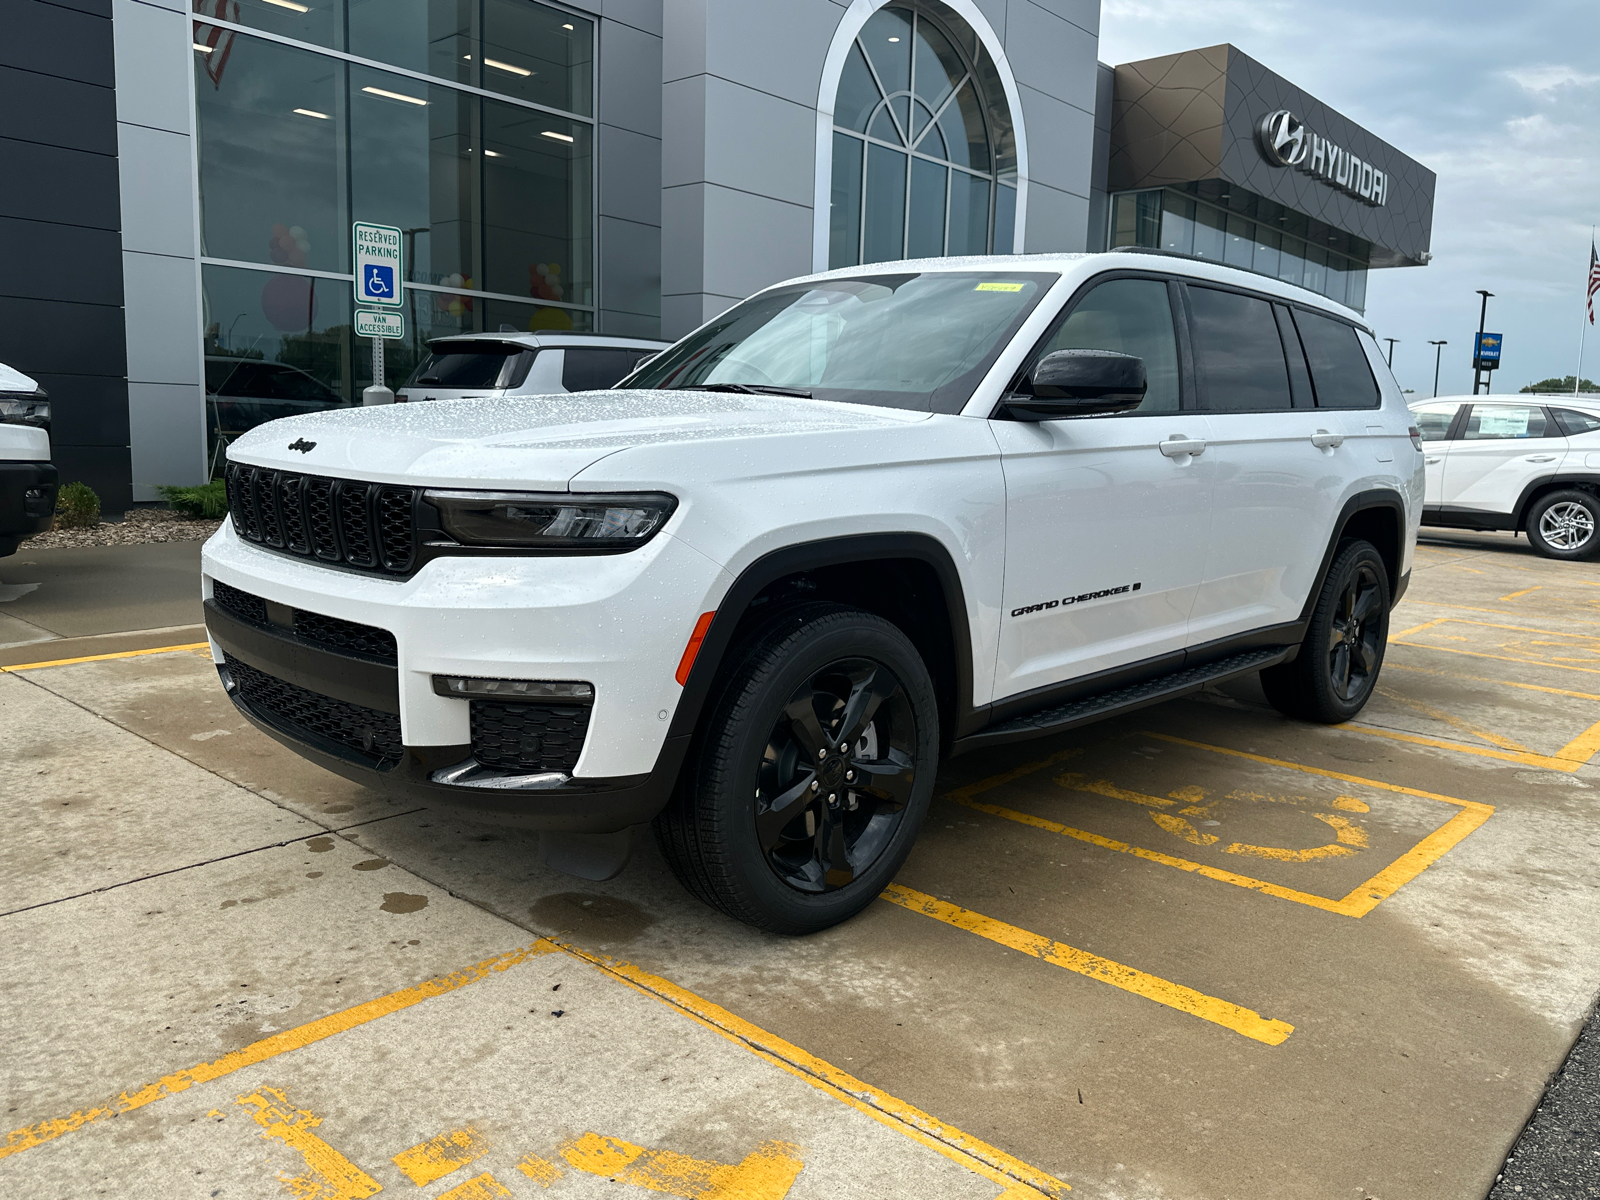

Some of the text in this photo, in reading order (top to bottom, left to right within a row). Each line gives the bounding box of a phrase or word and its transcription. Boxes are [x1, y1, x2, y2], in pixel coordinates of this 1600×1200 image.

[1310, 133, 1388, 207] HYUNDAI
[358, 230, 397, 246] RESERVED
[358, 244, 398, 259] PARKING
[373, 315, 387, 324] VAN
[359, 323, 400, 334] ACCESSIBLE
[288, 437, 318, 454] Jeep
[1011, 600, 1059, 617] GRAND
[1062, 585, 1130, 605] CHEROKEE
